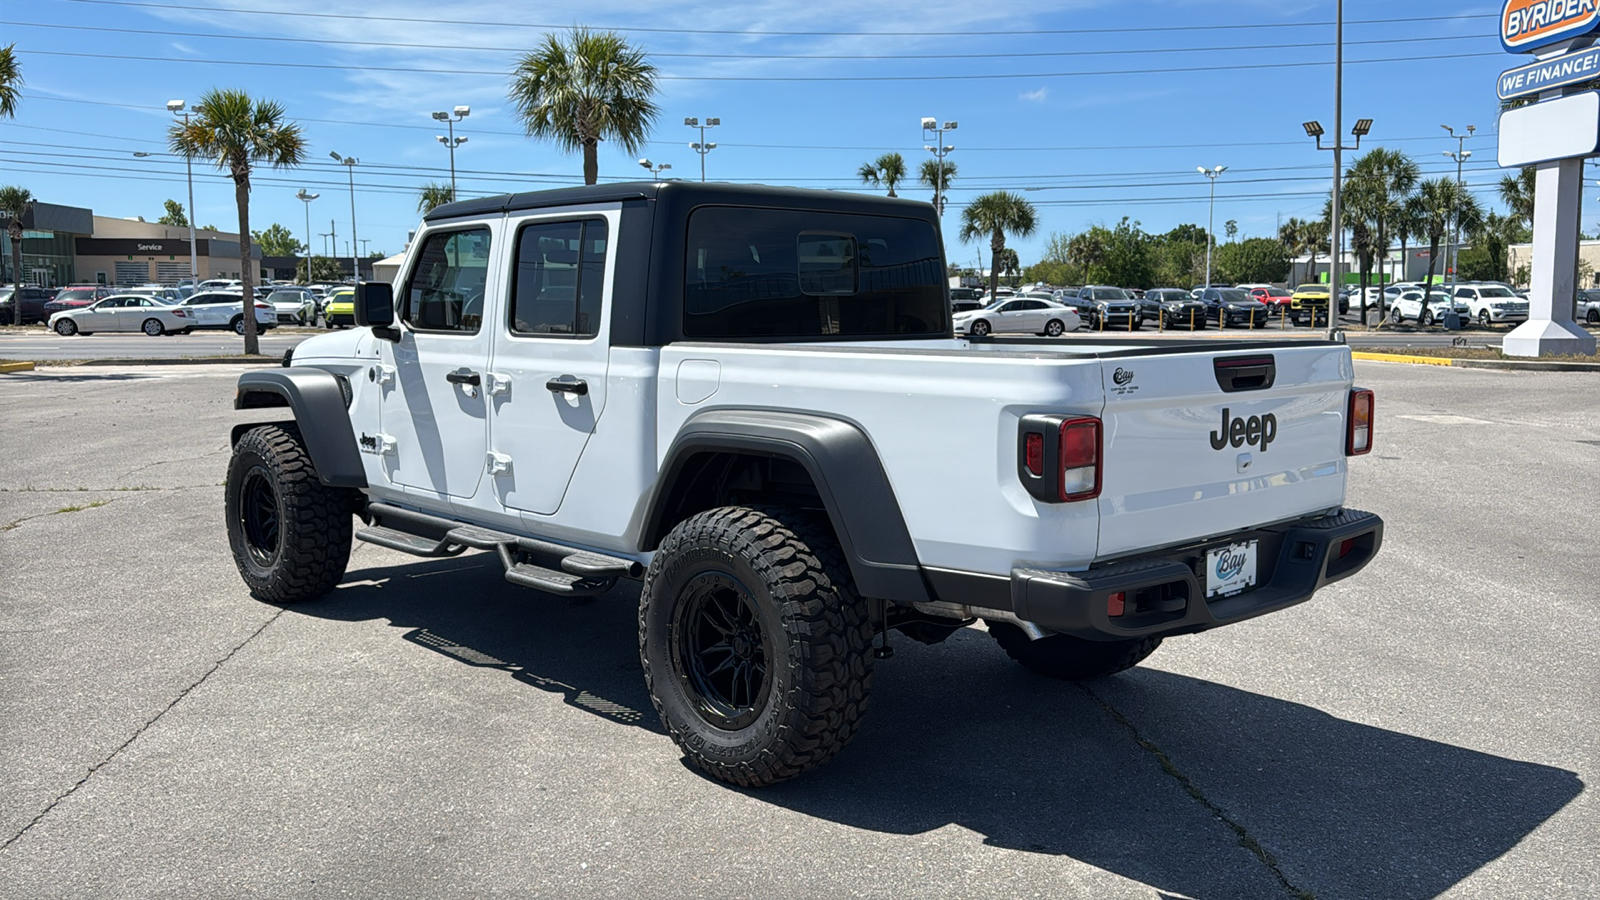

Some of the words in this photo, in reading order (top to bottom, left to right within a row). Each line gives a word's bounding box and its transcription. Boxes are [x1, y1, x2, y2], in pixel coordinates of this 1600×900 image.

[1506, 0, 1595, 38] BYRIDER
[1502, 74, 1524, 92] WE
[1526, 54, 1598, 86] FINANCE!
[137, 243, 163, 251] Service
[1113, 366, 1135, 386] Bay
[1210, 408, 1277, 452] Jeep
[1217, 550, 1247, 576] Bay
